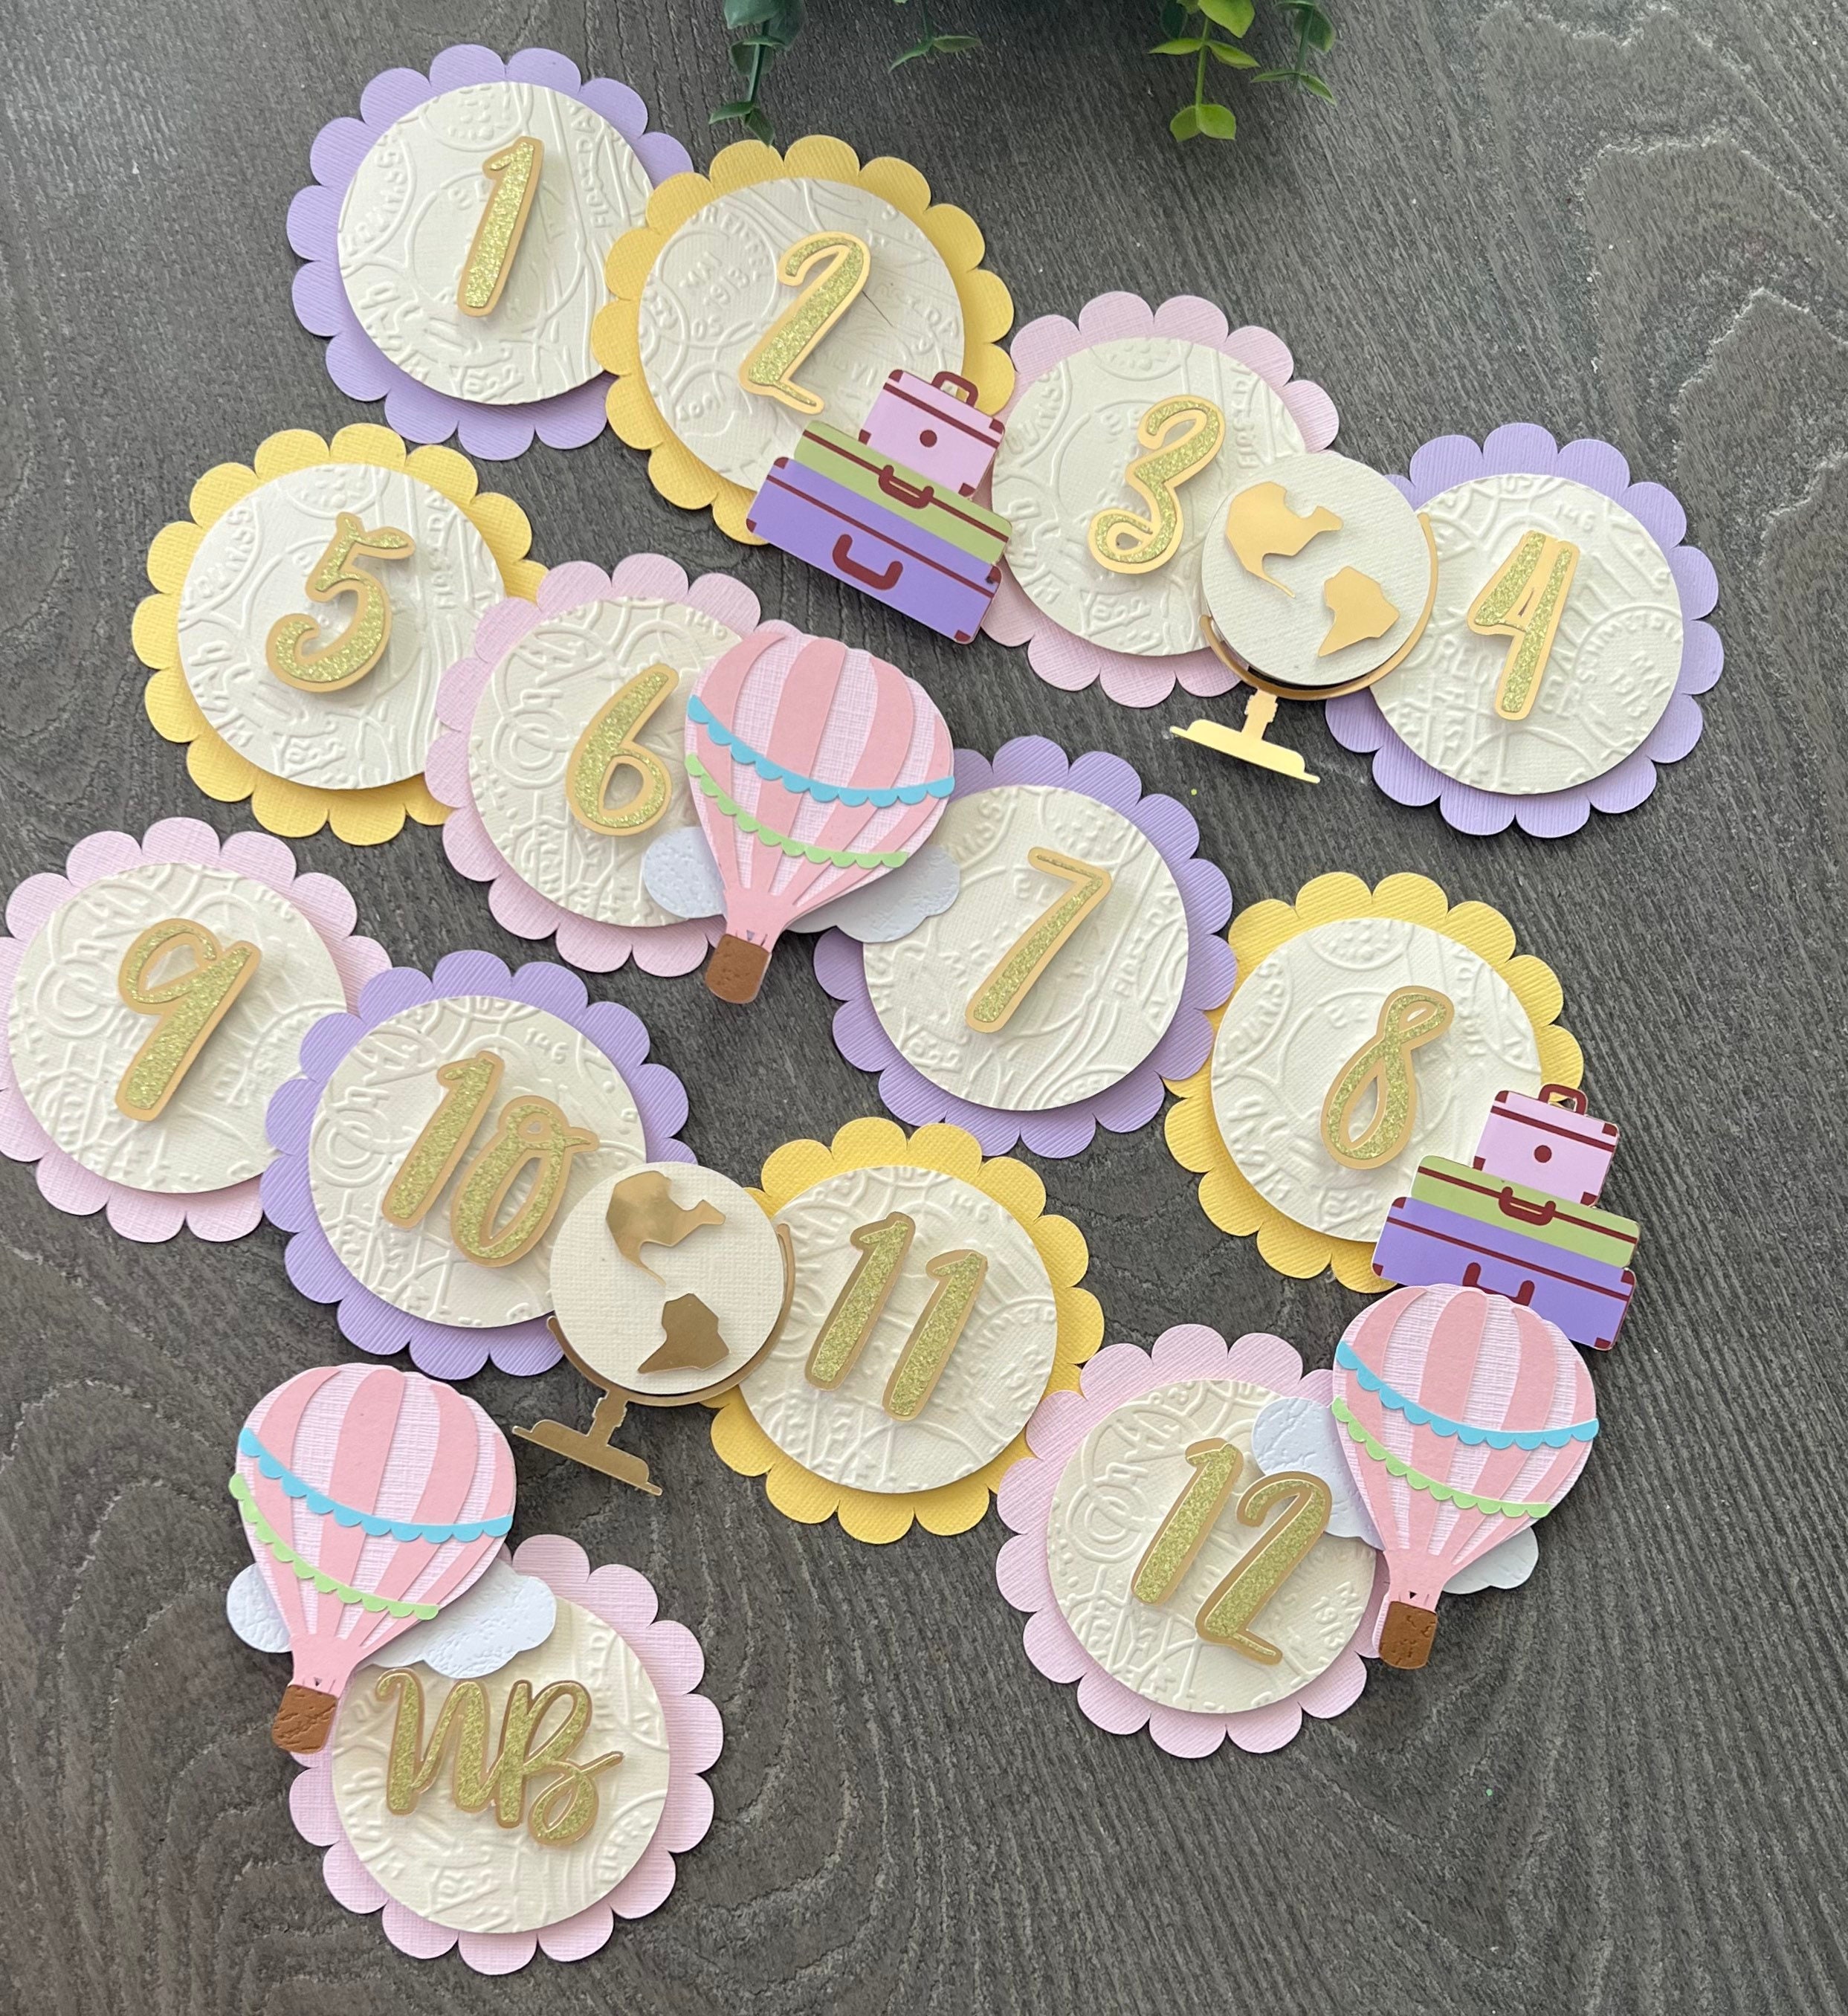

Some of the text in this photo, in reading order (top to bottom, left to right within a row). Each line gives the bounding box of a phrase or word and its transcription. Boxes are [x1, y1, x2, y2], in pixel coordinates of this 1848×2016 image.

[456, 136, 543, 316] 1
[740, 231, 870, 414] 2
[1088, 395, 1226, 574] 3
[266, 512, 416, 692] 5
[1467, 530, 1579, 720] 4
[566, 662, 679, 836] 6
[115, 918, 262, 1122] 9
[965, 847, 1112, 1033] 7
[381, 1050, 599, 1267] 10
[1320, 985, 1455, 1170] 8
[804, 1212, 989, 1421] 11
[1131, 1438, 1332, 1664] 12
[375, 1668, 624, 1846] NB
